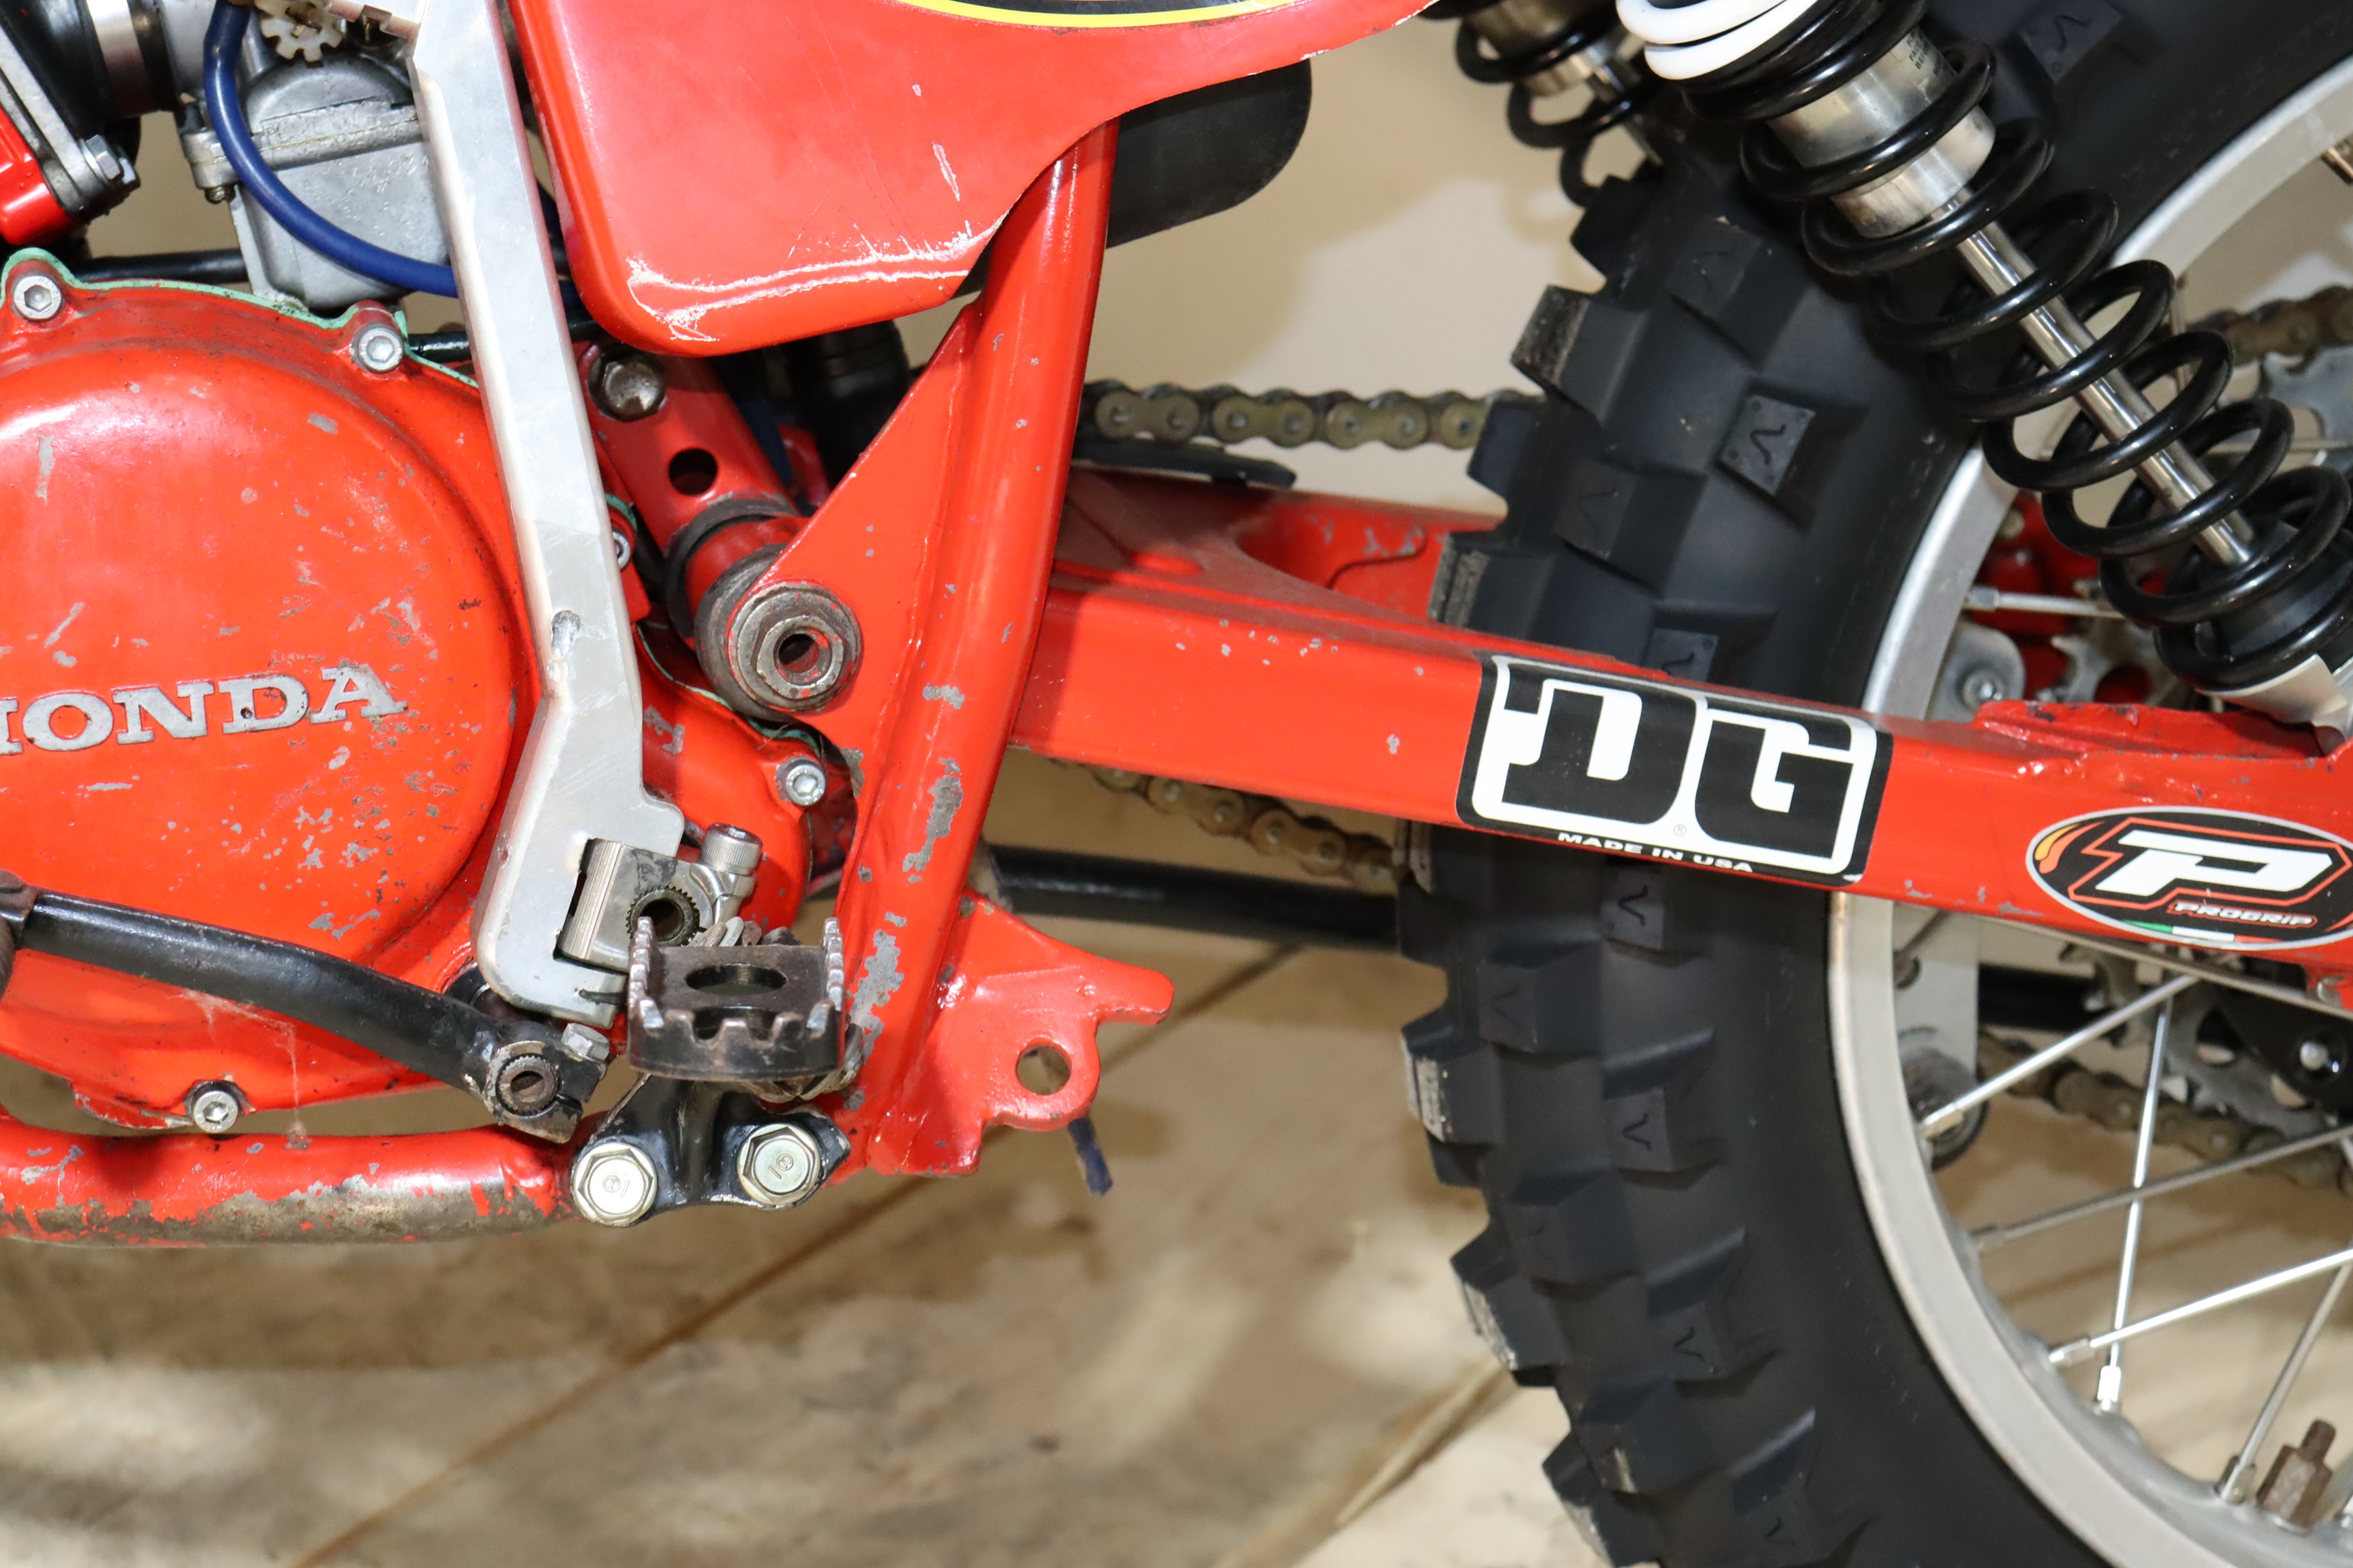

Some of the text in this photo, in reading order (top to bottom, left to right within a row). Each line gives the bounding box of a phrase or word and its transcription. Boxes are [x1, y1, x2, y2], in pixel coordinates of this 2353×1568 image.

[0, 663, 407, 755] ONDA
[1557, 832, 1753, 873] MADE IN USA
[2173, 901, 2314, 926] PROGRIP
